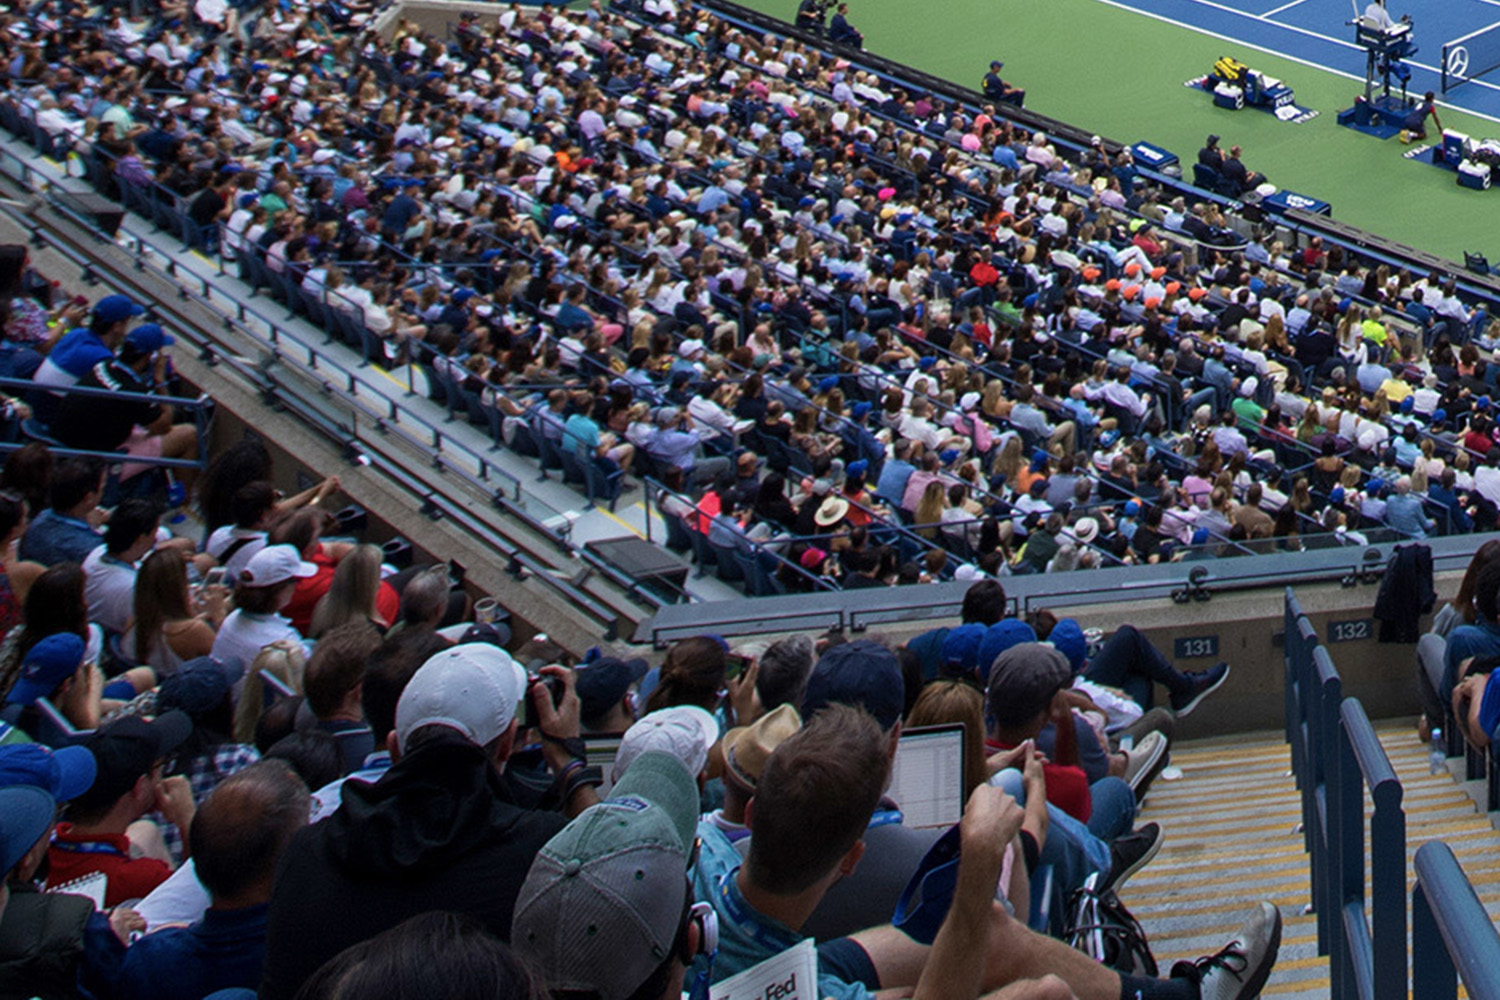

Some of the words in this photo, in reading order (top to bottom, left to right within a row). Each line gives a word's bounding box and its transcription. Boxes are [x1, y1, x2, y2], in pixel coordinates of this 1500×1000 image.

[1334, 622, 1367, 640] 132
[1183, 639, 1213, 656] 131
[765, 972, 796, 1000] Fed
